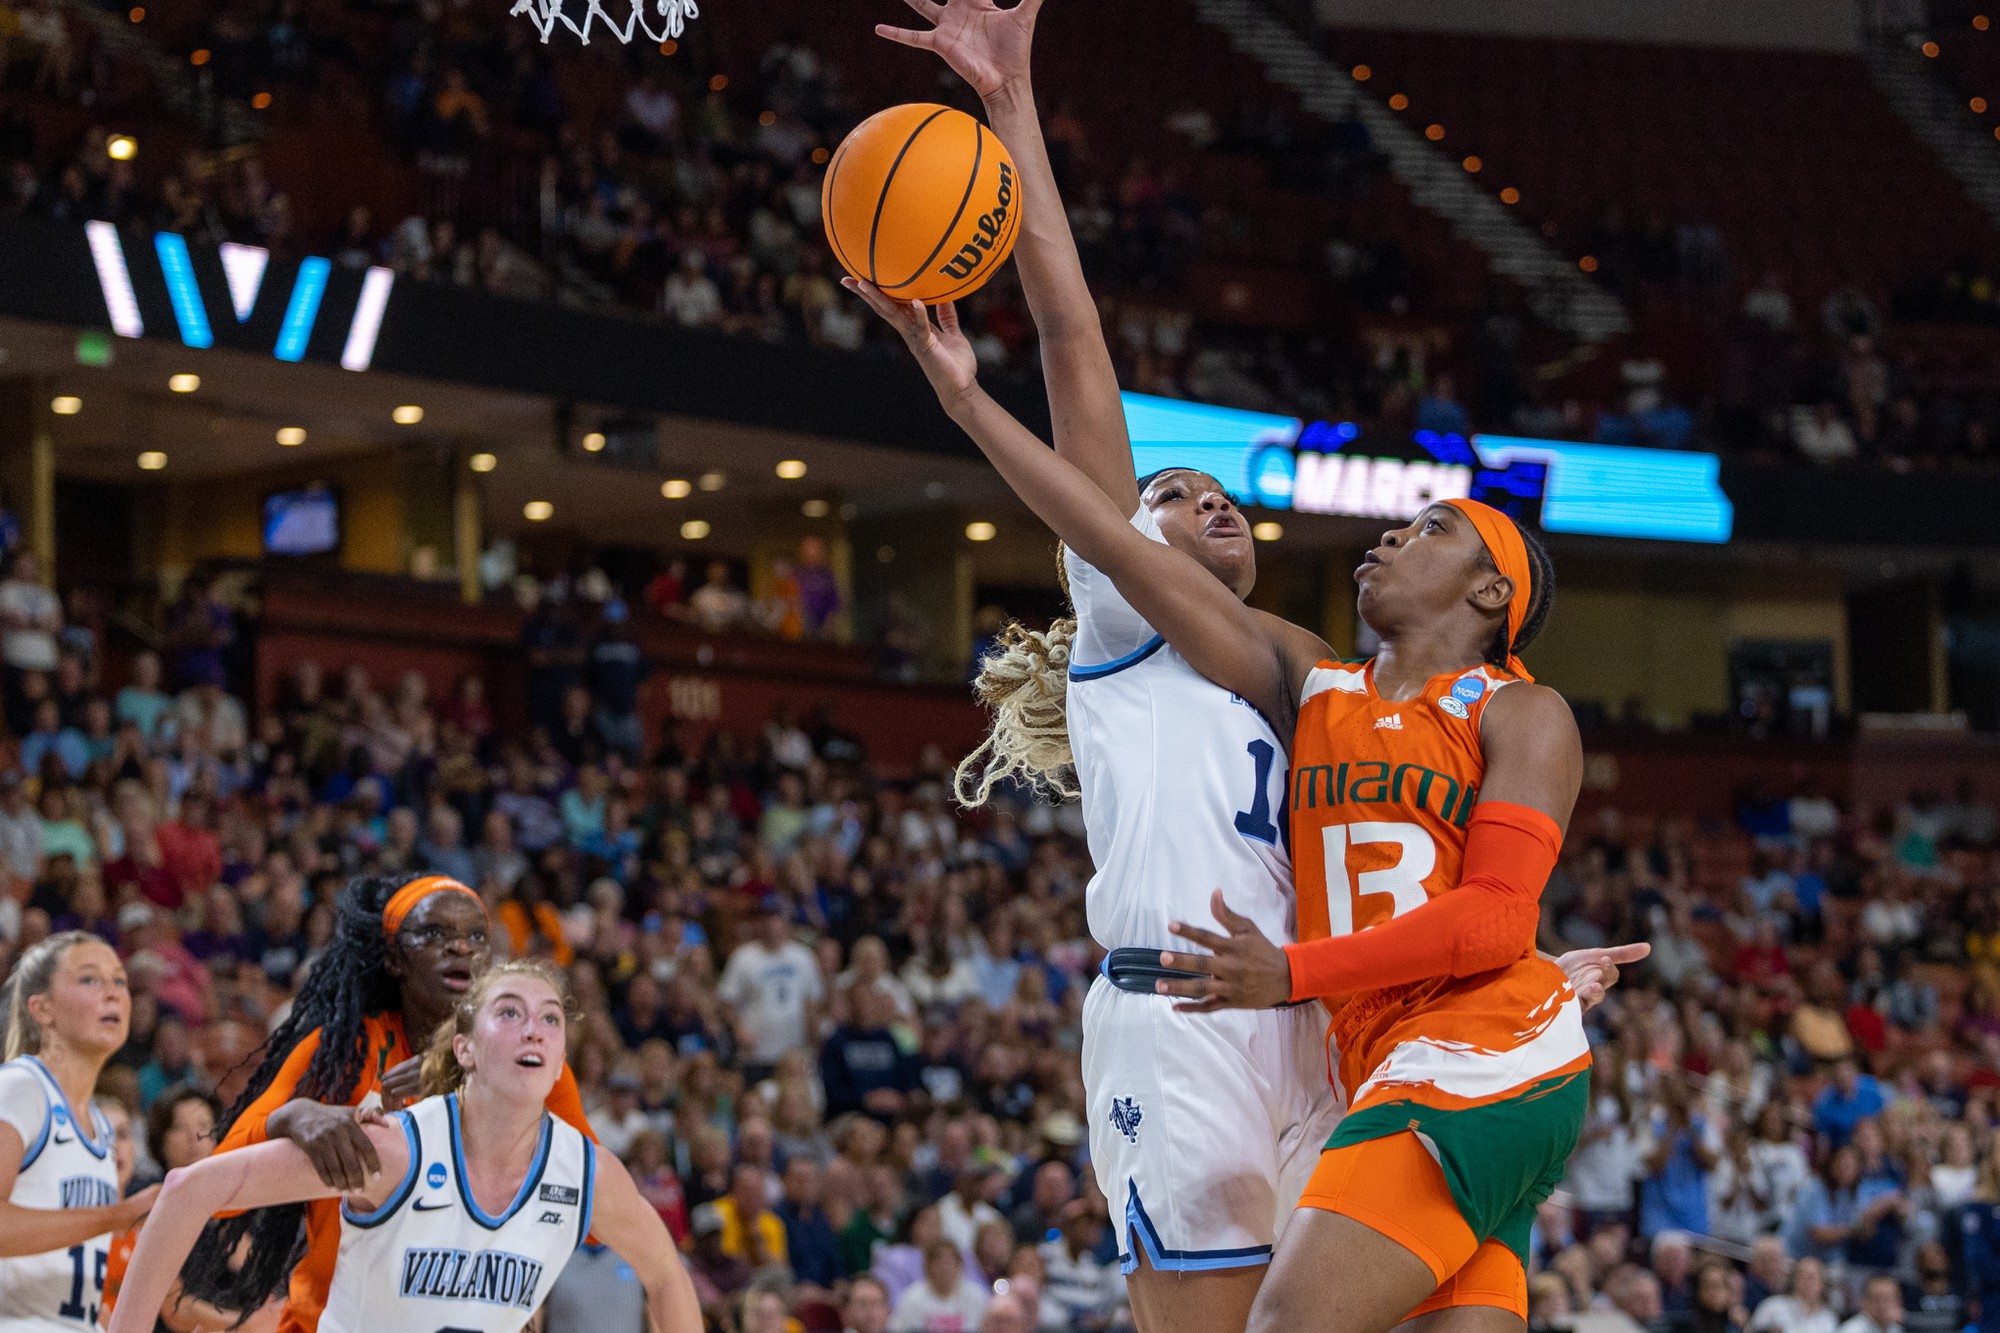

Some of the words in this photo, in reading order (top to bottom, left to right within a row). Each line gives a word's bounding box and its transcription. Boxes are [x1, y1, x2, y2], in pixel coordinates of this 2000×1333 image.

[939, 161, 1013, 280] Wilson
[1454, 686, 1481, 700] NCAA
[1373, 722, 1404, 730] adidas
[401, 1248, 544, 1311] VILLANOVA
